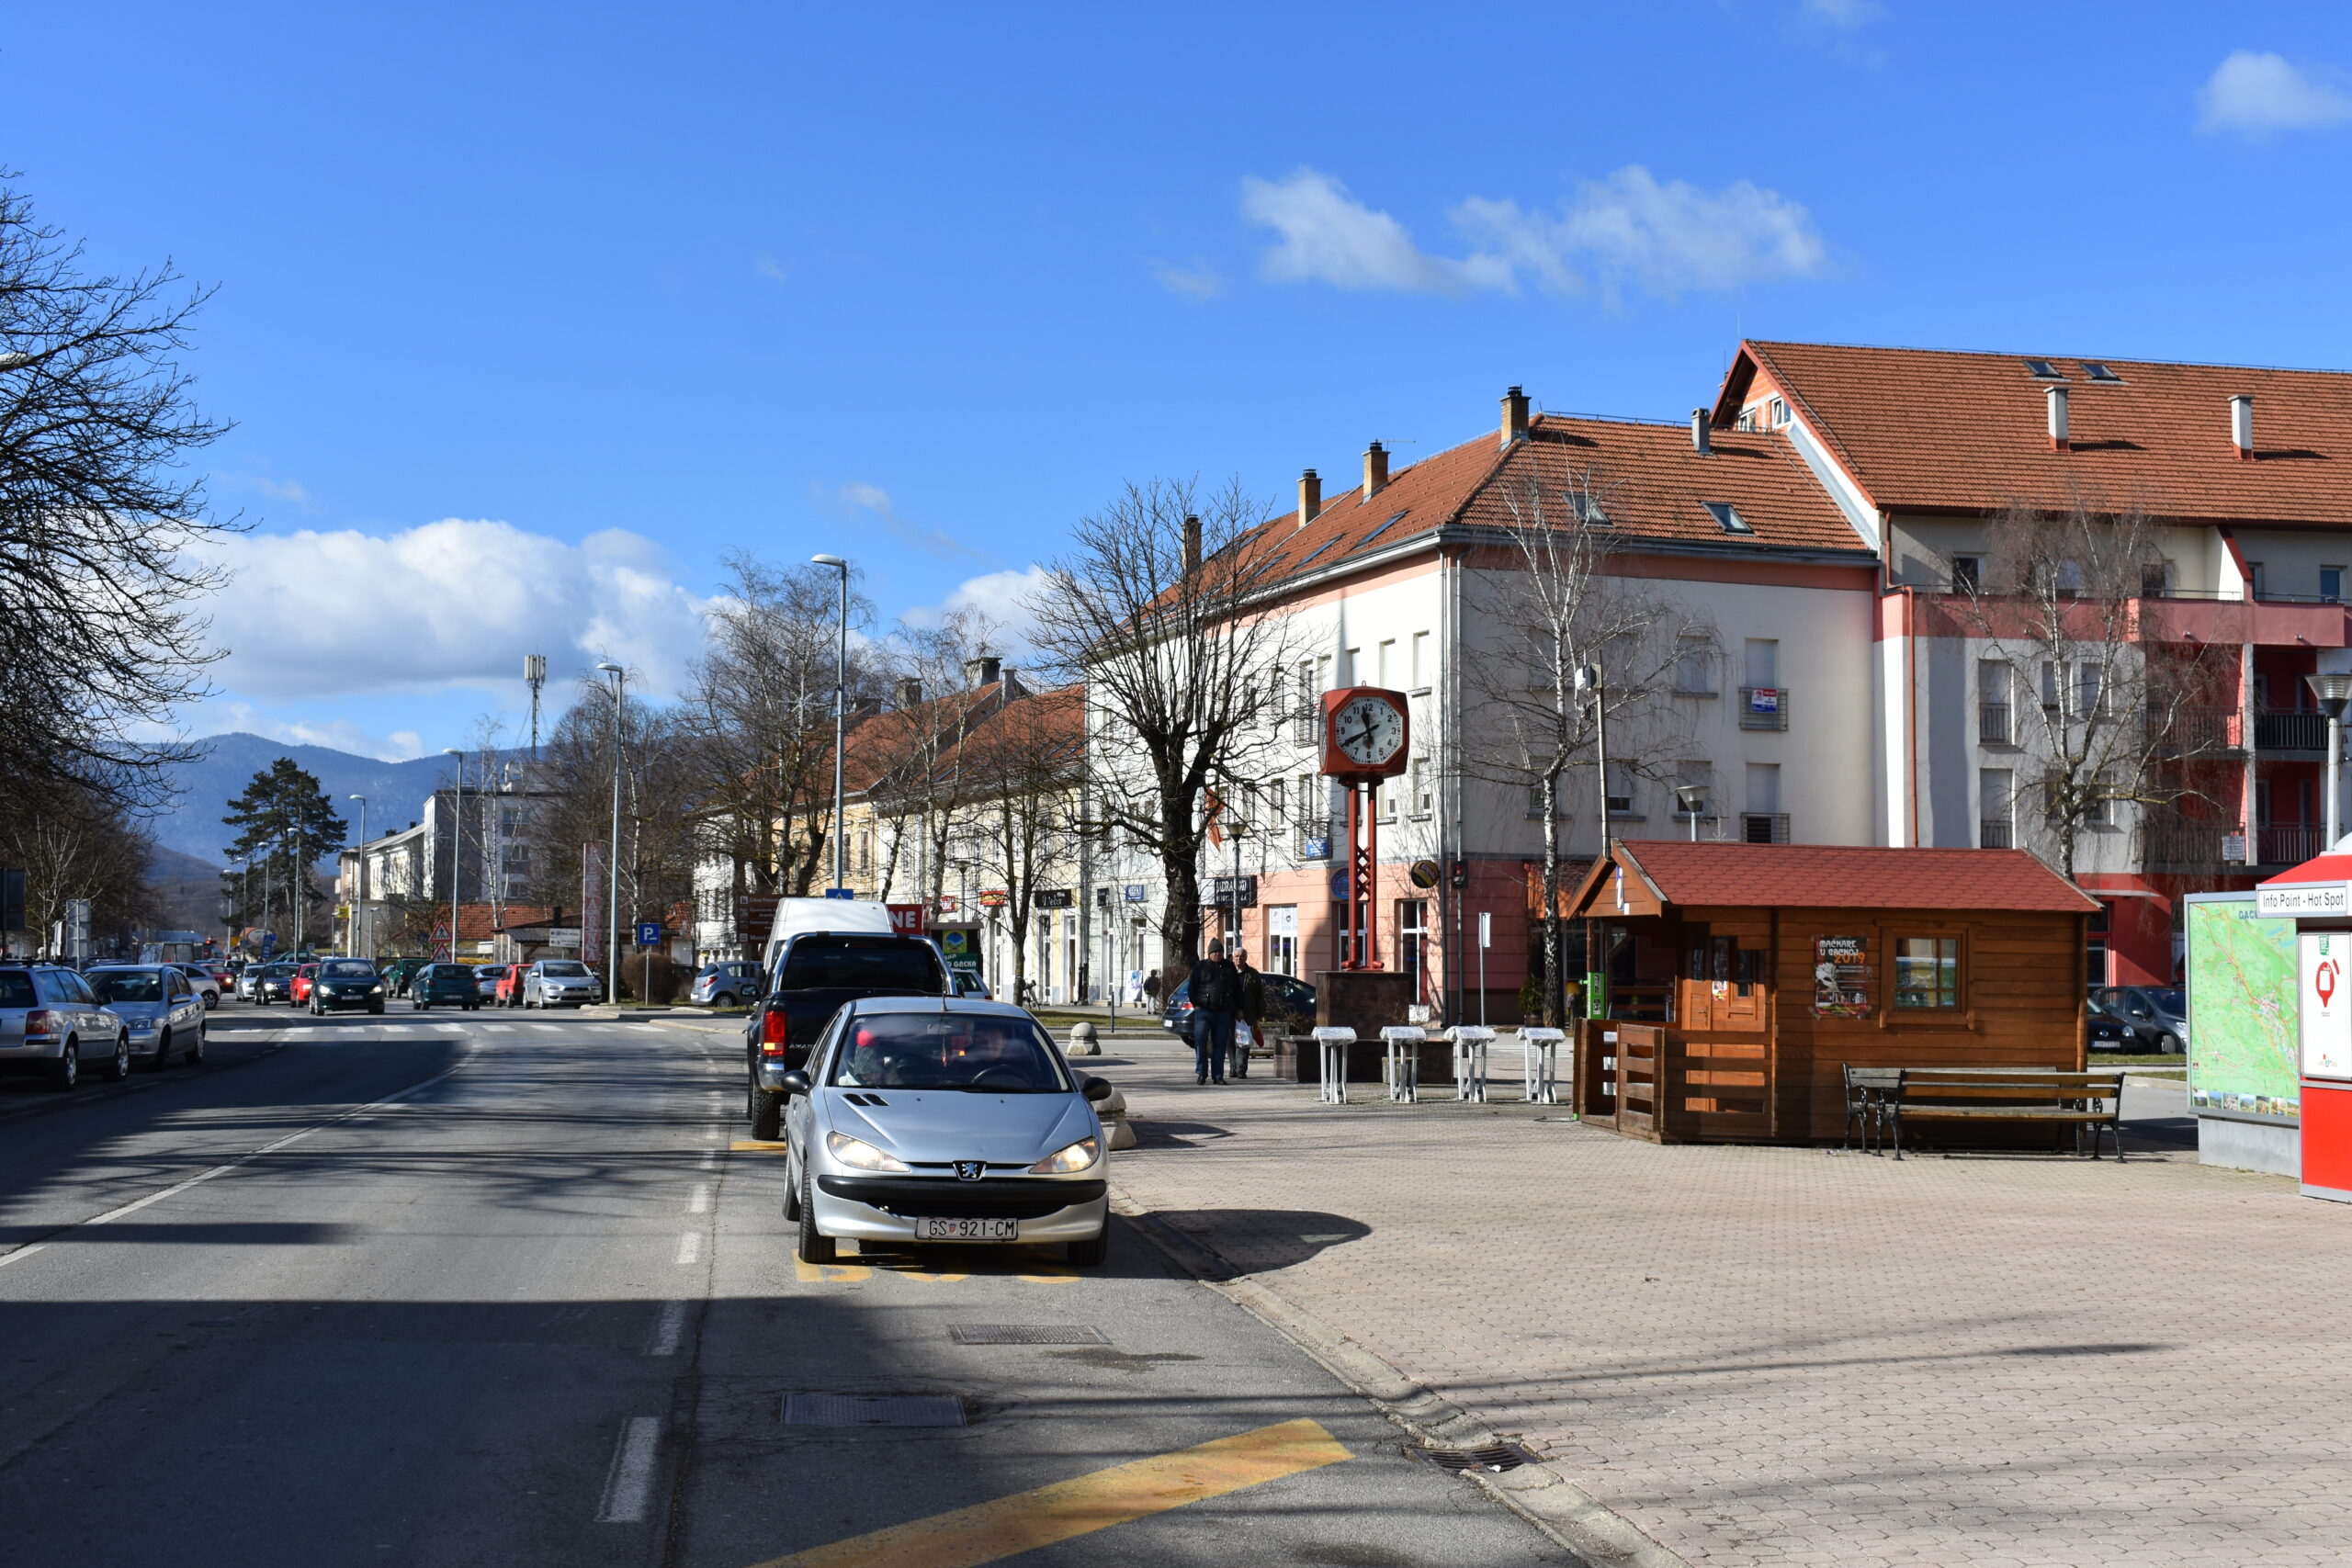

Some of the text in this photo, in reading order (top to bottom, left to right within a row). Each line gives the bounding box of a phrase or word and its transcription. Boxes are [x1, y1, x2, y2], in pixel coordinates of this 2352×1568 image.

[1353, 706, 1360, 715] 11
[1364, 703, 1373, 711] 12
[1344, 716, 1352, 724] 10
[1387, 715, 1393, 723] 2
[1340, 727, 1346, 735] 9
[1391, 727, 1396, 735] 3
[1387, 739, 1393, 747] 4
[1353, 747, 1359, 756] 7
[1366, 750, 1372, 759] 6
[1379, 747, 1384, 756] 5
[2263, 894, 2278, 908] Info
[2279, 893, 2301, 908] Point
[2307, 894, 2323, 907] Hot
[2324, 892, 2344, 909] Spot
[643, 927, 654, 941] P
[1834, 952, 1866, 964] 2019
[929, 1220, 947, 1235] GS
